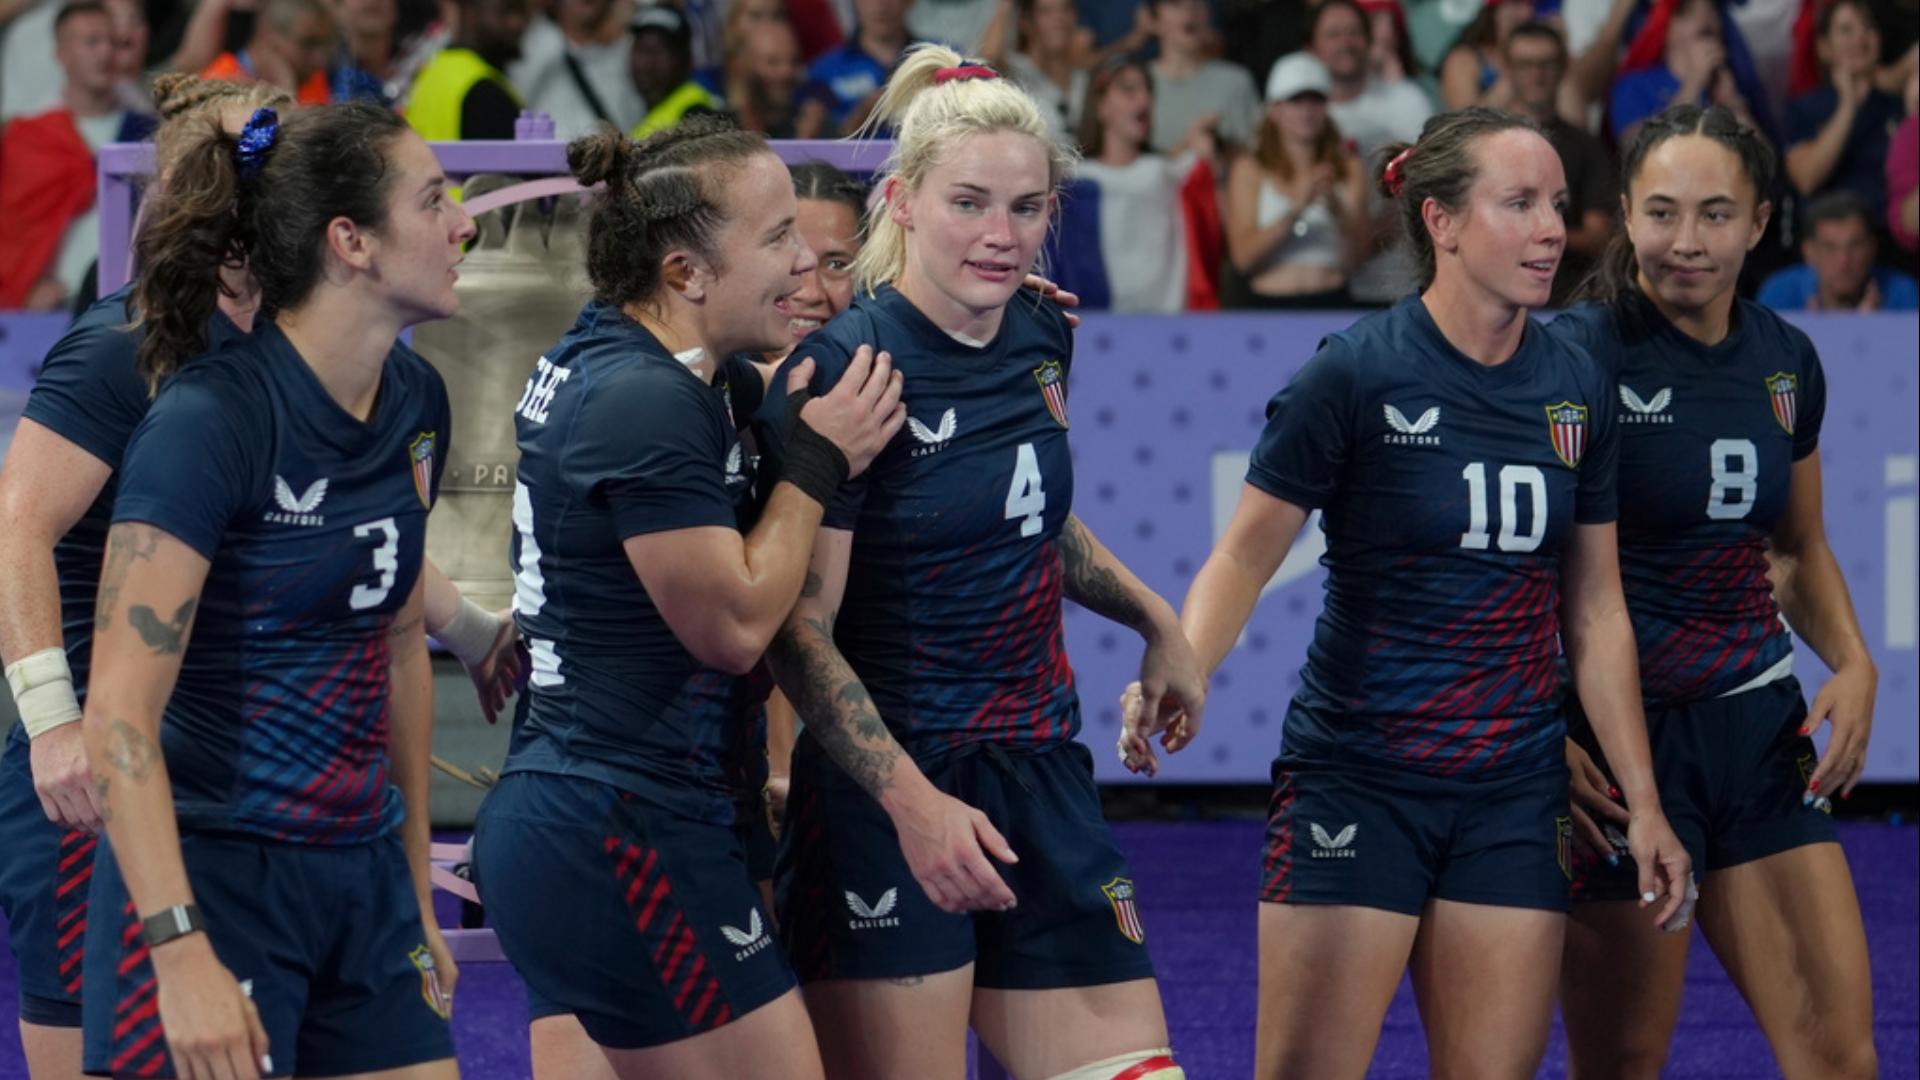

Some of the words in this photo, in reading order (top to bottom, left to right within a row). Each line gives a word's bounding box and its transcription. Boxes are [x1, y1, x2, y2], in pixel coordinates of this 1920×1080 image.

[1558, 410, 1580, 422] USA
[1619, 414, 1673, 423] CASTORE
[1384, 435, 1440, 445] CASTORE
[1005, 442, 1046, 537] 4
[1706, 438, 1758, 520] 8
[1459, 462, 1548, 552] 10
[349, 516, 400, 610] 3
[849, 917, 900, 930] CASTORE
